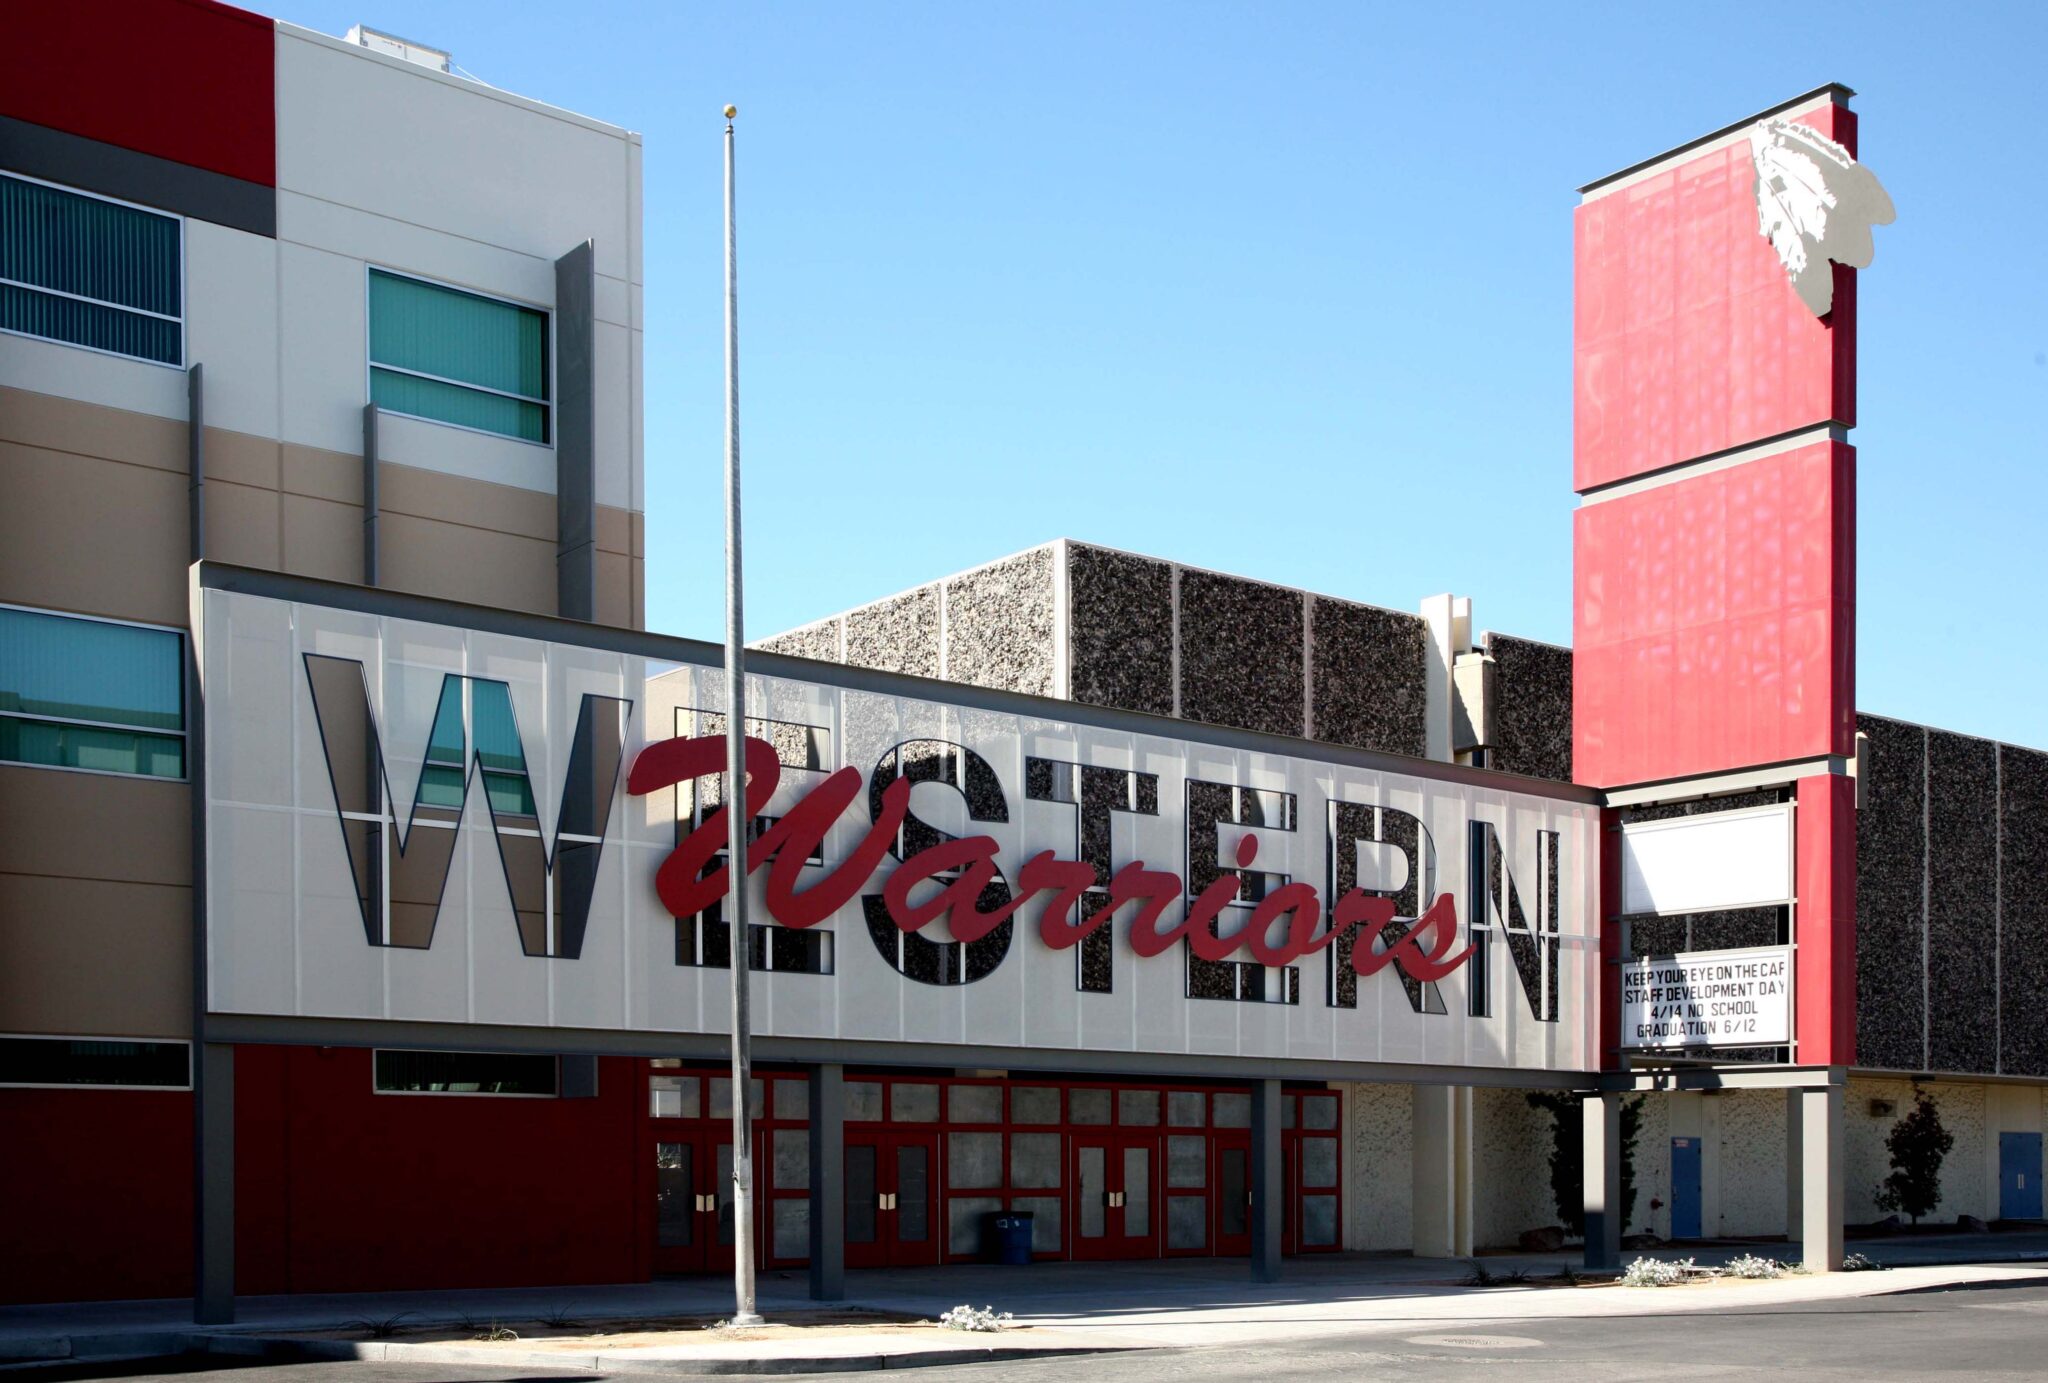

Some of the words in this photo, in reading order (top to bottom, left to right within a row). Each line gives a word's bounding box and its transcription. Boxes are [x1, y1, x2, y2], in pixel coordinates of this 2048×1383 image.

[302, 652, 1560, 1022] WESTERN
[627, 735, 1477, 982] Warriors
[1625, 971, 1654, 987] KEEP
[1656, 969, 1687, 985] YOUR
[1690, 967, 1714, 982] EYE
[1716, 965, 1732, 980] ON
[1734, 963, 1758, 979] THE
[1625, 988, 1663, 1004] STAFF
[1666, 982, 1754, 1002] DEVELOPMENT
[1759, 980, 1785, 996] DAY
[1651, 1004, 1682, 1019] 4/14
[1688, 1003, 1704, 1018] NO
[1711, 1000, 1758, 1017] SCHOOL
[1637, 1021, 1716, 1039] GRADUATION
[1724, 1018, 1756, 1034] 6/12
